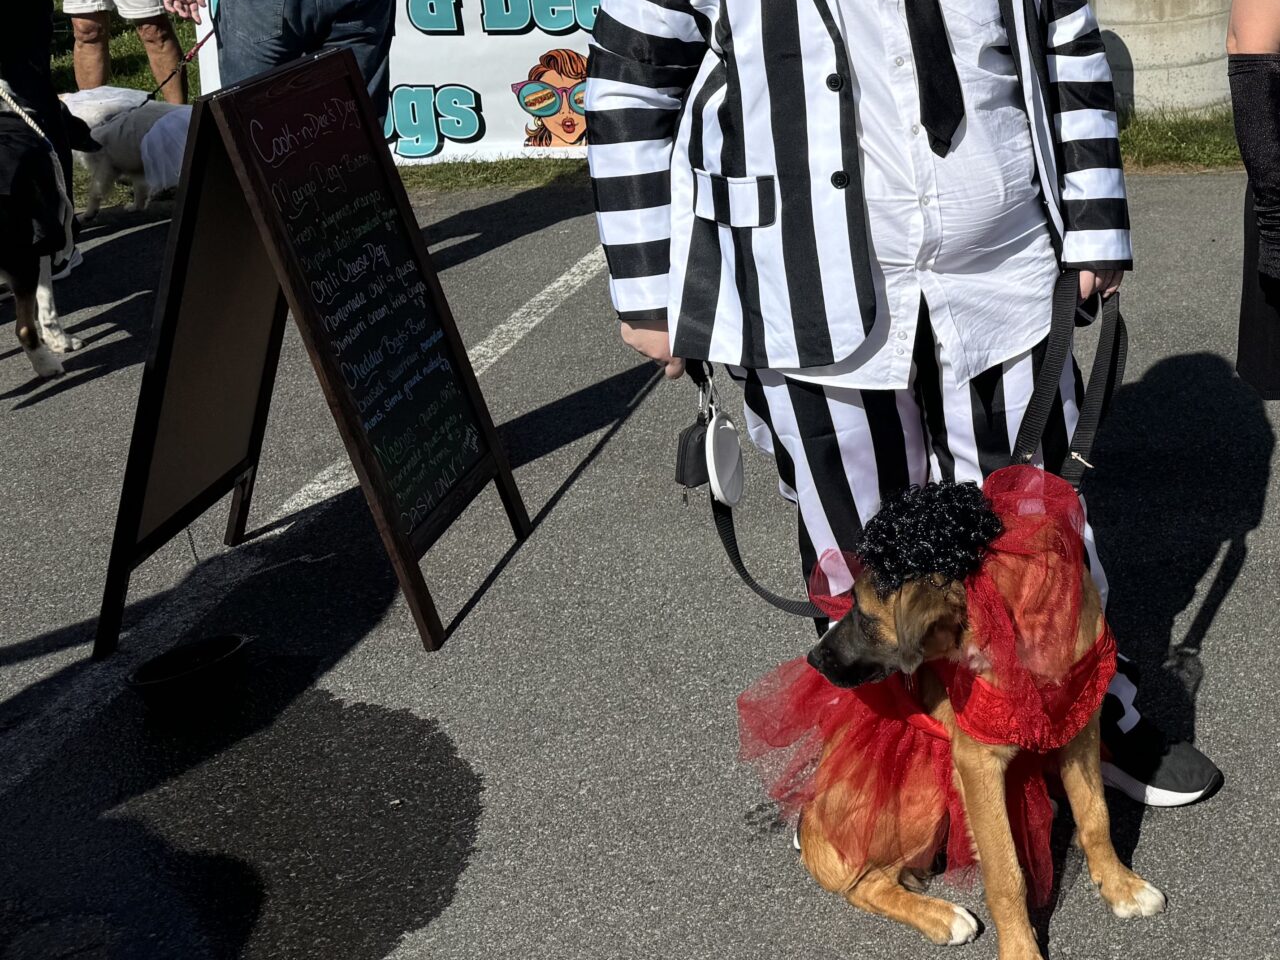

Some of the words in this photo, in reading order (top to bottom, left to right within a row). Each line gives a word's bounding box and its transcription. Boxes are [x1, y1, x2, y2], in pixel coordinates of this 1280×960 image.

[384, 83, 487, 159] gs
[337, 254, 370, 283] Cheese
[400, 489, 436, 536] CASH
